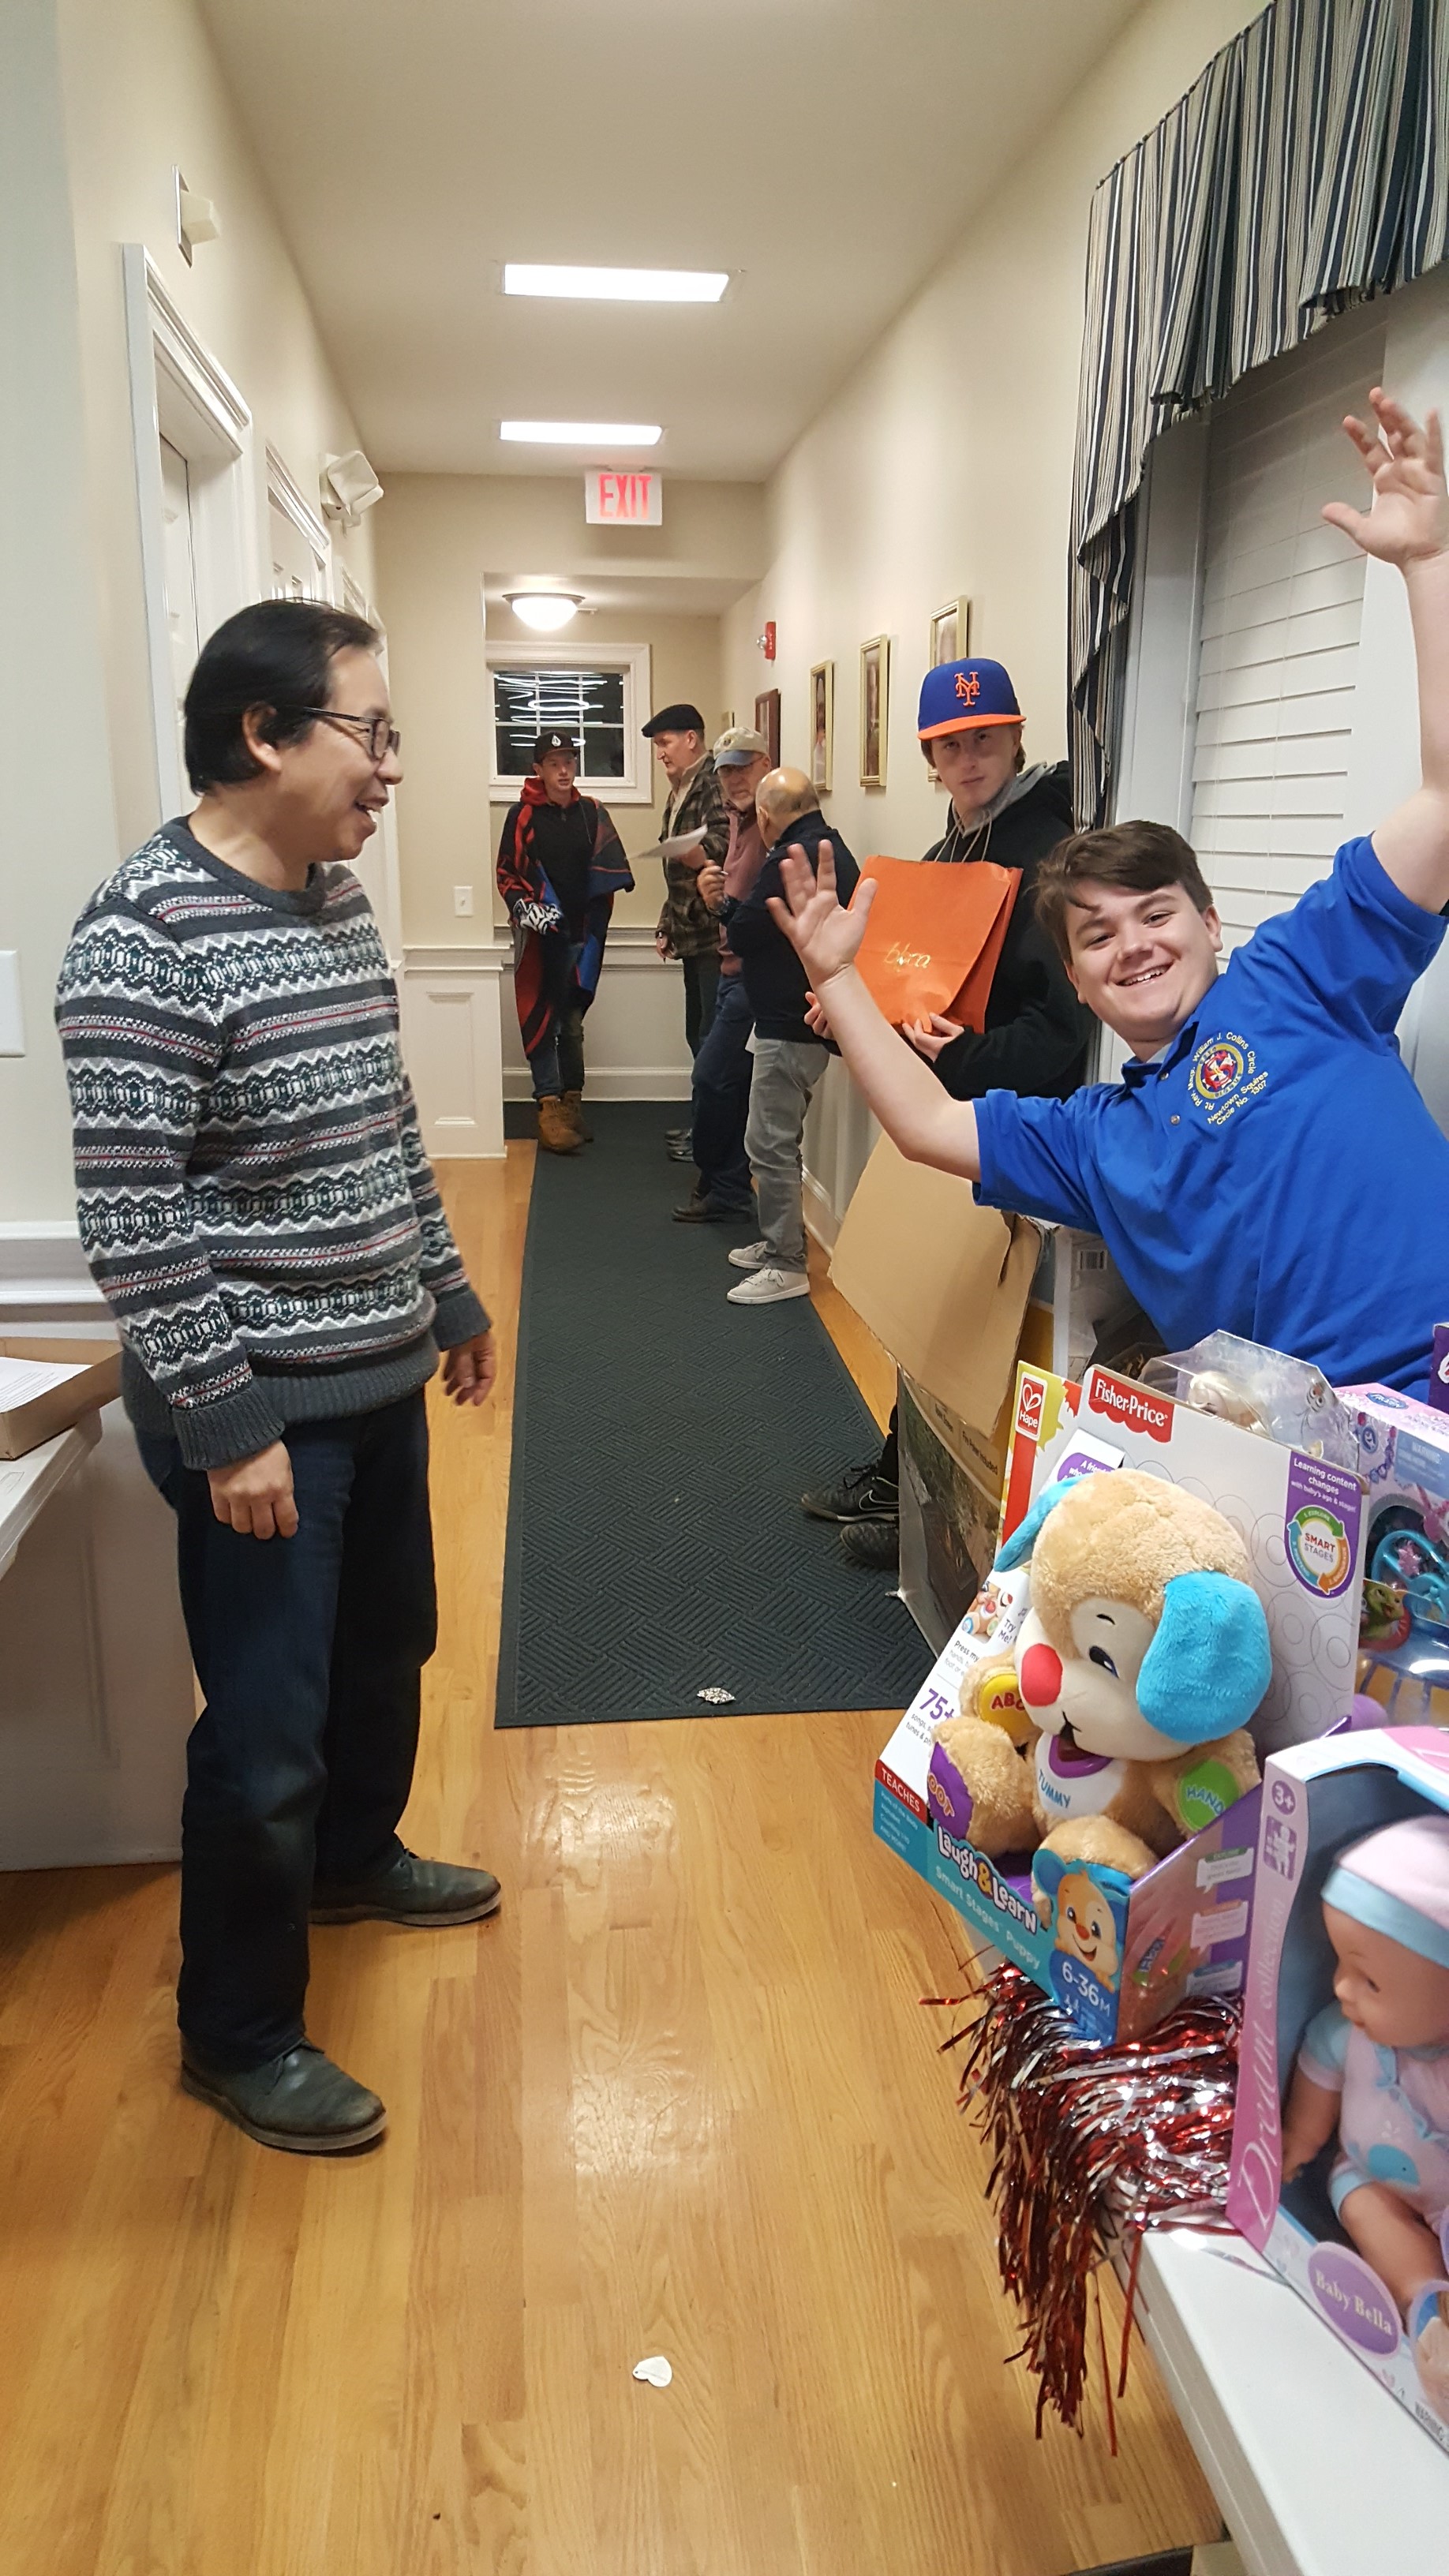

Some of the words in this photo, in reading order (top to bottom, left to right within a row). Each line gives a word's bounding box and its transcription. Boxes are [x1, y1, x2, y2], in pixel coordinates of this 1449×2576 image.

[599, 474, 652, 519] EXIT
[954, 672, 980, 706] NY
[1193, 1038, 1214, 1061] William
[1226, 1032, 1249, 1050] Collins
[1248, 1050, 1257, 1074] Circle
[1208, 1094, 1239, 1124] Newtown
[1240, 1071, 1268, 1094] Squires
[1216, 1107, 1234, 1125] Circle
[1250, 1080, 1267, 1095] 1307
[1019, 1410, 1039, 1428] Hape
[1095, 1378, 1166, 1427] Fisher-Price
[1294, 1458, 1326, 1479] Learning
[1327, 1473, 1357, 1492] content
[1308, 1477, 1339, 1496] changes
[1304, 1543, 1334, 1563] STAGES
[1305, 1533, 1335, 1553] SMART
[998, 1631, 1013, 1644] Me!
[1003, 1619, 1017, 1633] Try
[944, 1657, 955, 1670] foot
[953, 1640, 970, 1659] Press
[969, 1652, 980, 1663] my
[919, 1688, 955, 1720] 75+
[991, 1692, 1026, 1711] ABC
[906, 1721, 919, 1736] tunes
[911, 1713, 927, 1730] songs,
[882, 1767, 920, 1813] TEACHES
[927, 1772, 955, 1817] OOT
[1038, 1769, 1071, 1809] TUMMY
[1185, 1784, 1225, 1817] HAND
[1274, 1784, 1294, 1811] 3+
[938, 1825, 979, 1881] Laugh
[935, 1866, 964, 1899] Smart
[966, 1892, 1001, 1933] Stages
[1006, 1930, 1041, 1970] Puppy
[1237, 2020, 1278, 2232] Dream
[1259, 1897, 1286, 2009] collection
[1315, 2269, 1350, 2311] Baby
[1354, 2295, 1392, 2336] Bella
